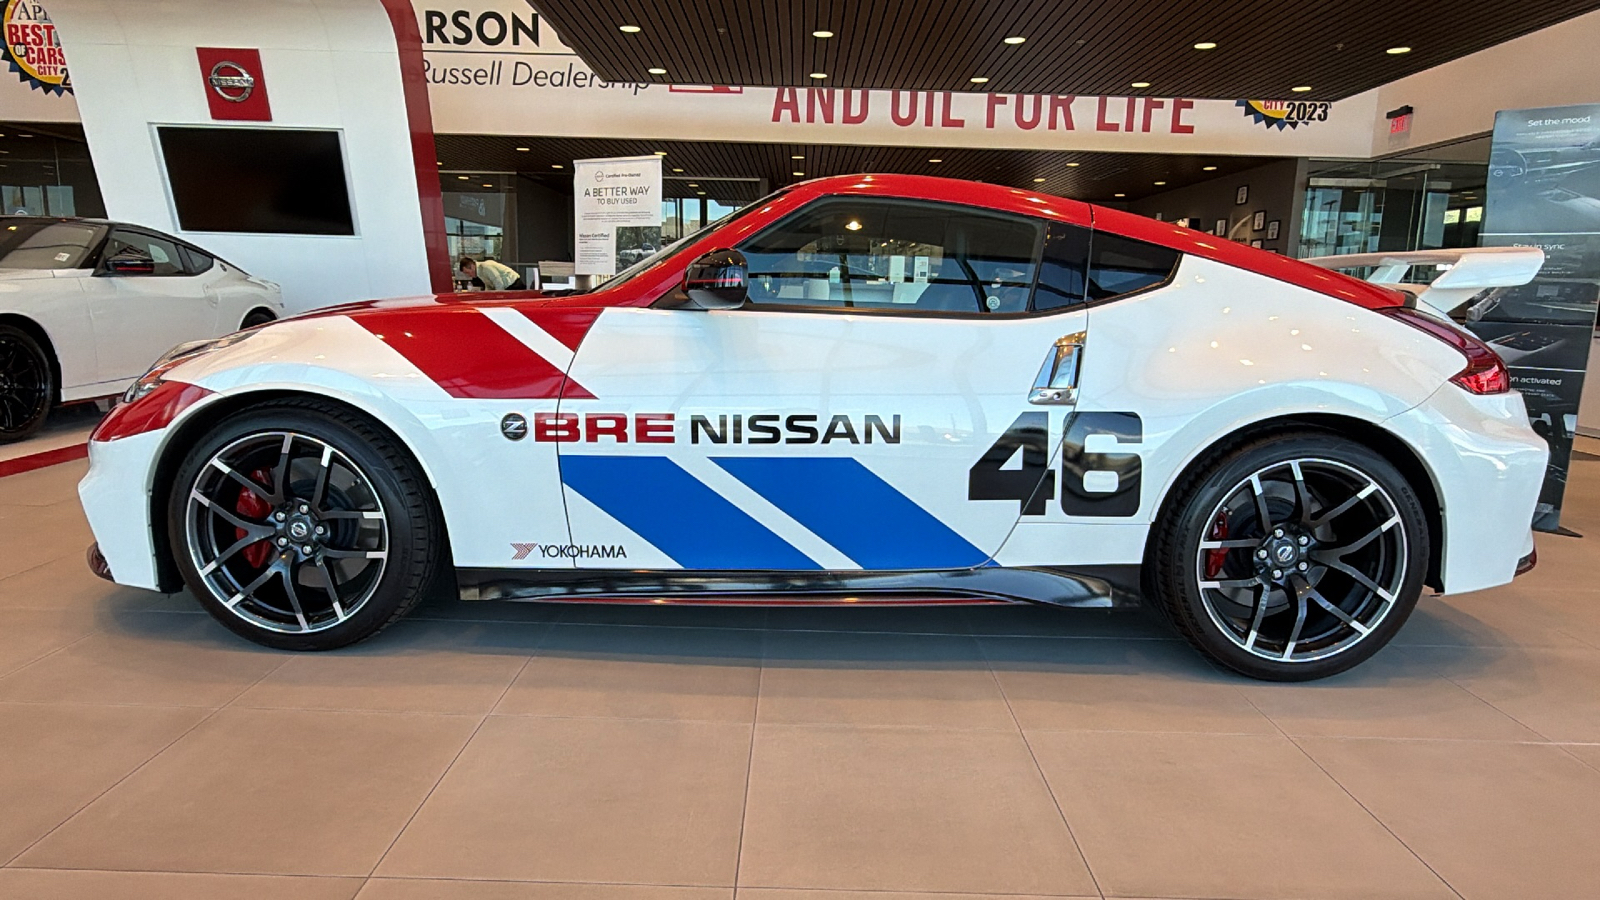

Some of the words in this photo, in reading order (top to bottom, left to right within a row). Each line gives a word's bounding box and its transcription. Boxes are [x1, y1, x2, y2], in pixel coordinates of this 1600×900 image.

[7, 24, 55, 46] BEST
[420, 10, 540, 47] RSON
[15, 45, 26, 56] OF
[37, 66, 58, 76] CITY
[512, 61, 649, 96] Dealerp
[771, 87, 869, 124] AND
[890, 89, 965, 128] OIL
[986, 92, 1075, 131] FOR
[1096, 96, 1195, 134] LIFE
[1263, 100, 1285, 111] CITY
[1285, 102, 1329, 121] 2023
[1527, 119, 1543, 127] Set
[1544, 118, 1560, 126] the
[1561, 115, 1591, 125] mood
[584, 188, 591, 198] A
[593, 186, 628, 197] BETTER
[630, 186, 650, 195] WAY
[1543, 243, 1566, 251] sync
[1520, 377, 1562, 386] activated
[534, 412, 676, 443] BRE
[691, 414, 902, 445] NISSAN
[968, 411, 1143, 517] 46
[538, 544, 628, 559] YOKOHAMA
